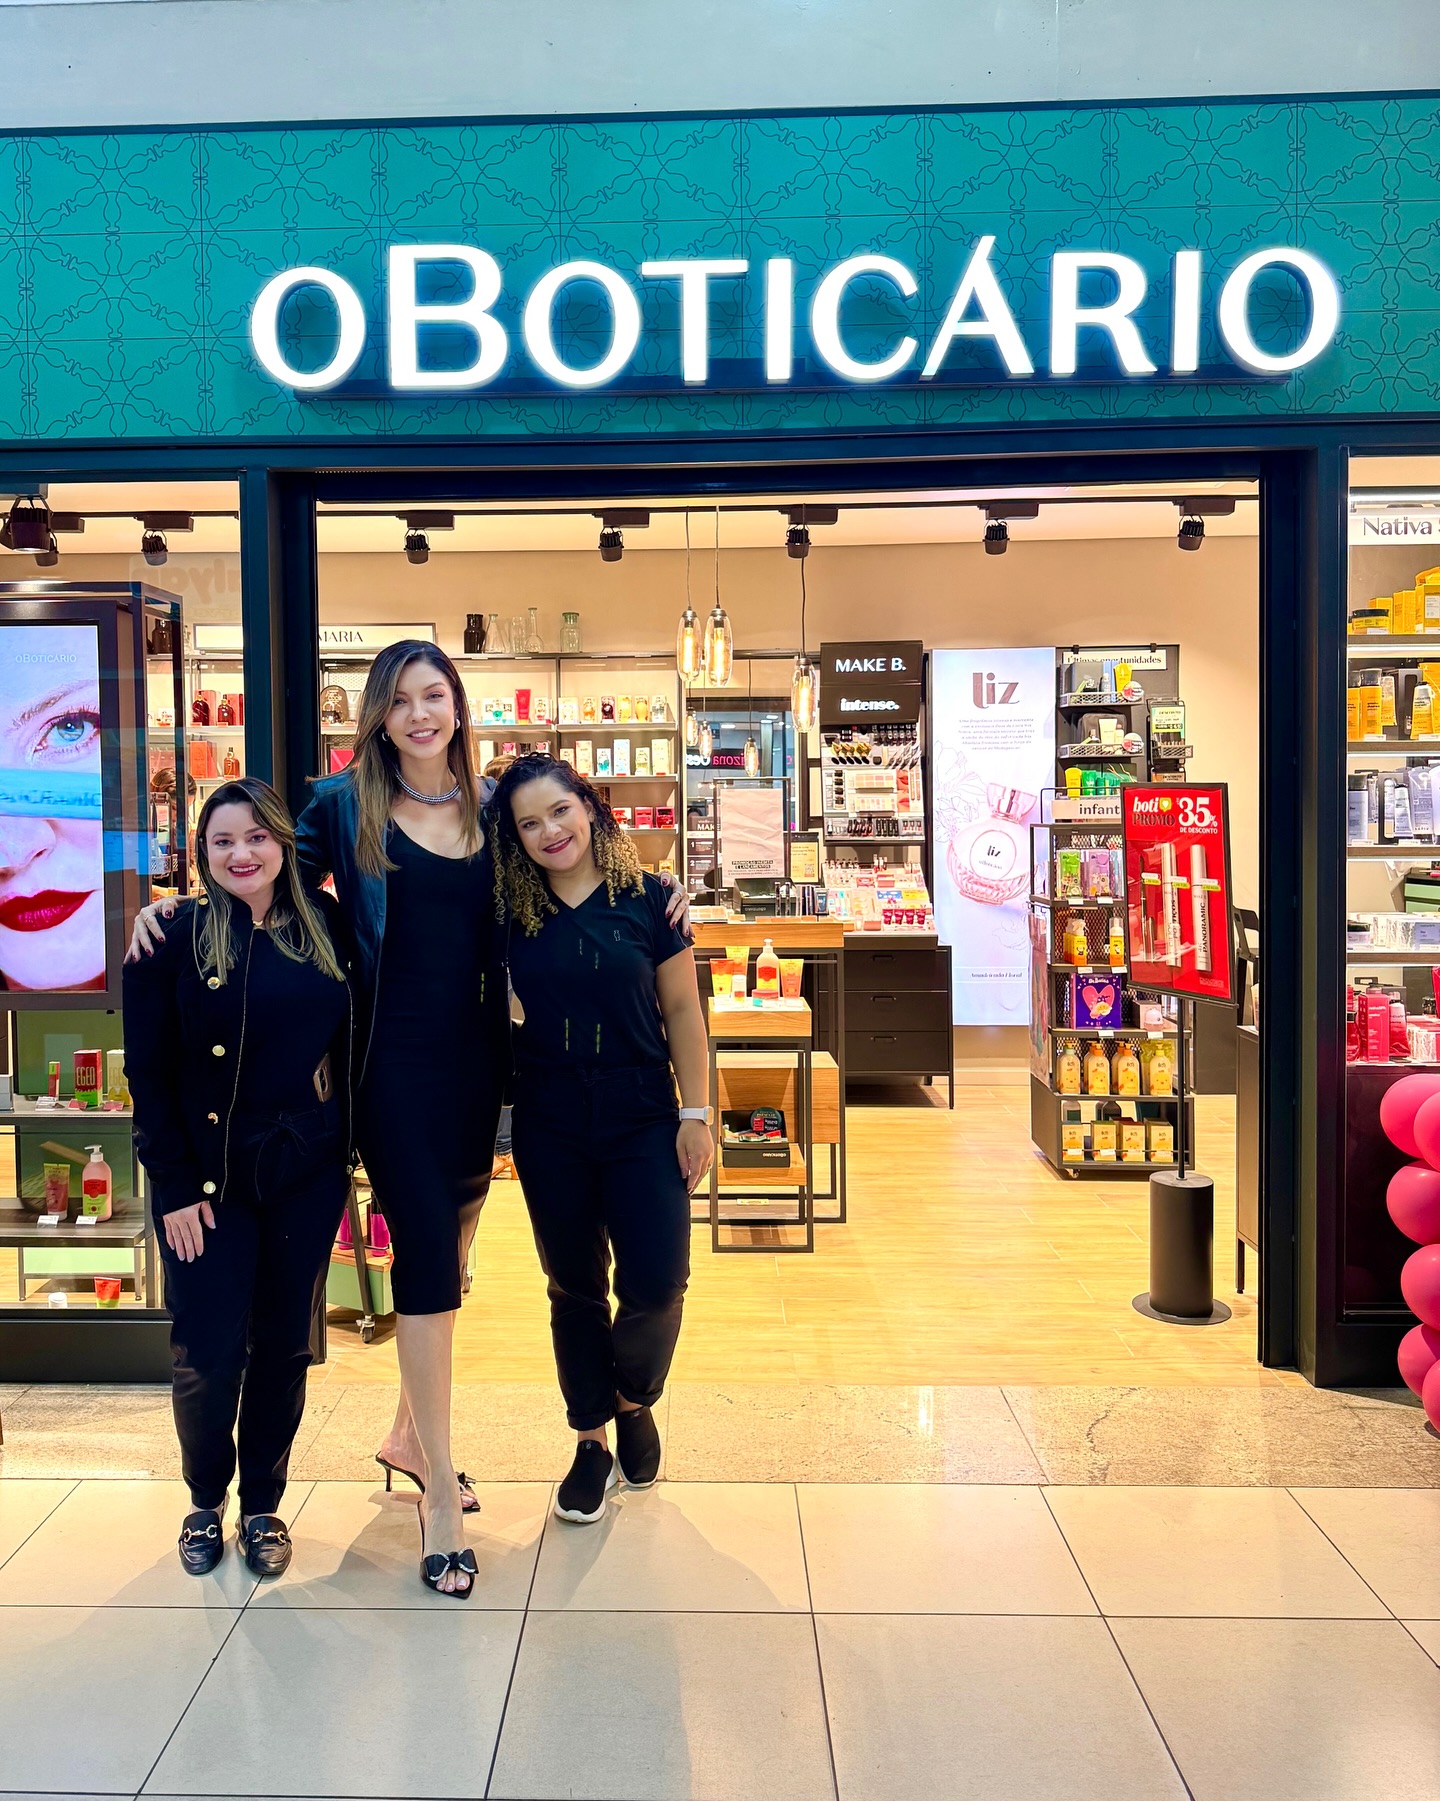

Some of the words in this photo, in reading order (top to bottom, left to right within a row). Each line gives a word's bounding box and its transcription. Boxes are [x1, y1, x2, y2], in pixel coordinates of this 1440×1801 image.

[1363, 516, 1432, 536] Nativa
[835, 658, 886, 672] MAKE
[891, 658, 907, 671] B.
[972, 672, 1020, 709] liz
[840, 698, 900, 712] intense.
[1080, 804, 1120, 814] infant
[1133, 796, 1159, 812] boti
[1132, 814, 1175, 826] PROMO
[76, 1066, 96, 1086] EGEO
